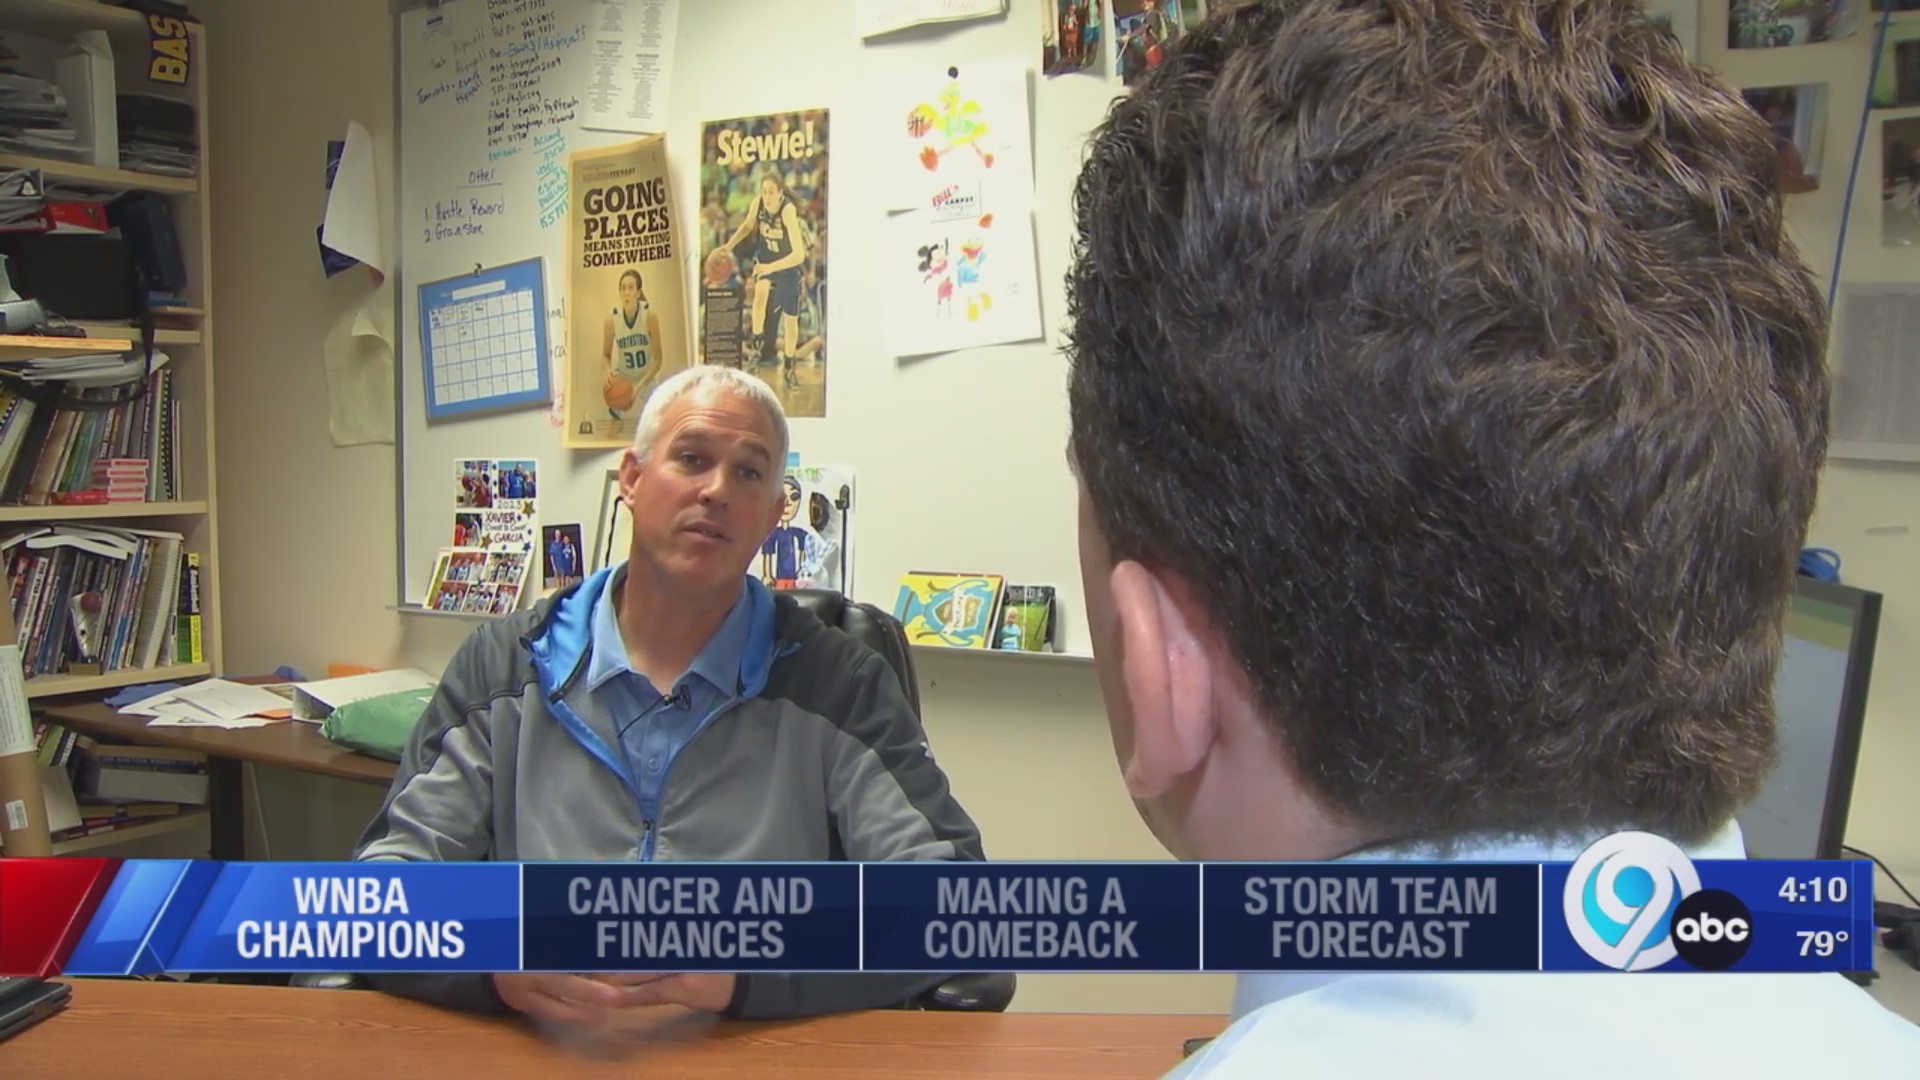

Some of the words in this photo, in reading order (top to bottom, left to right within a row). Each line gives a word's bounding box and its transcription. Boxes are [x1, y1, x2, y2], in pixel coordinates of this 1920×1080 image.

[150, 15, 189, 84] BAS
[717, 120, 814, 166] Stewie!
[583, 177, 666, 215] GOING
[583, 206, 670, 241] PLACES
[583, 238, 623, 253] MEANS
[623, 231, 671, 248] STARTING
[583, 243, 672, 268] SOMEWHERE
[623, 350, 646, 369] 30
